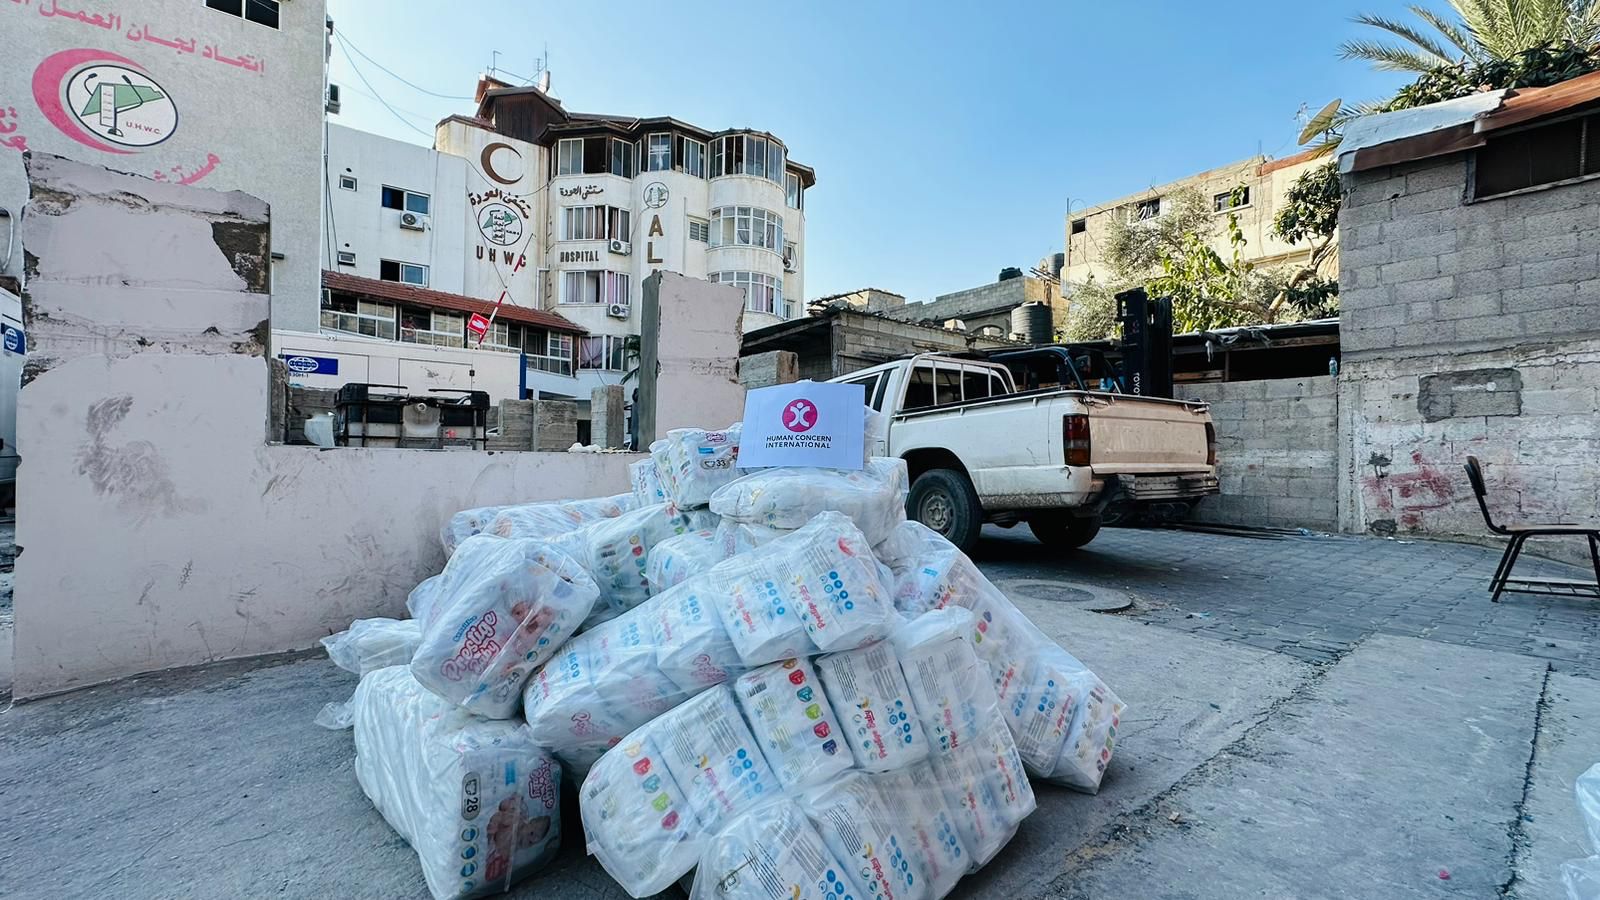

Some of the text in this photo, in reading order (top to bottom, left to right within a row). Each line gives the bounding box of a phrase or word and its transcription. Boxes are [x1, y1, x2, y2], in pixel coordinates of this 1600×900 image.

[559, 250, 600, 263] HOSPITAL
[1133, 372, 1142, 396] TOYO
[765, 441, 831, 449] INTERNATIONAL
[766, 434, 832, 442] HUMAN CONCERN
[716, 459, 726, 467] 33
[441, 610, 497, 682] Prestige
[864, 709, 877, 730] Baby
[466, 797, 479, 813] 28
[870, 856, 884, 881] Baby
